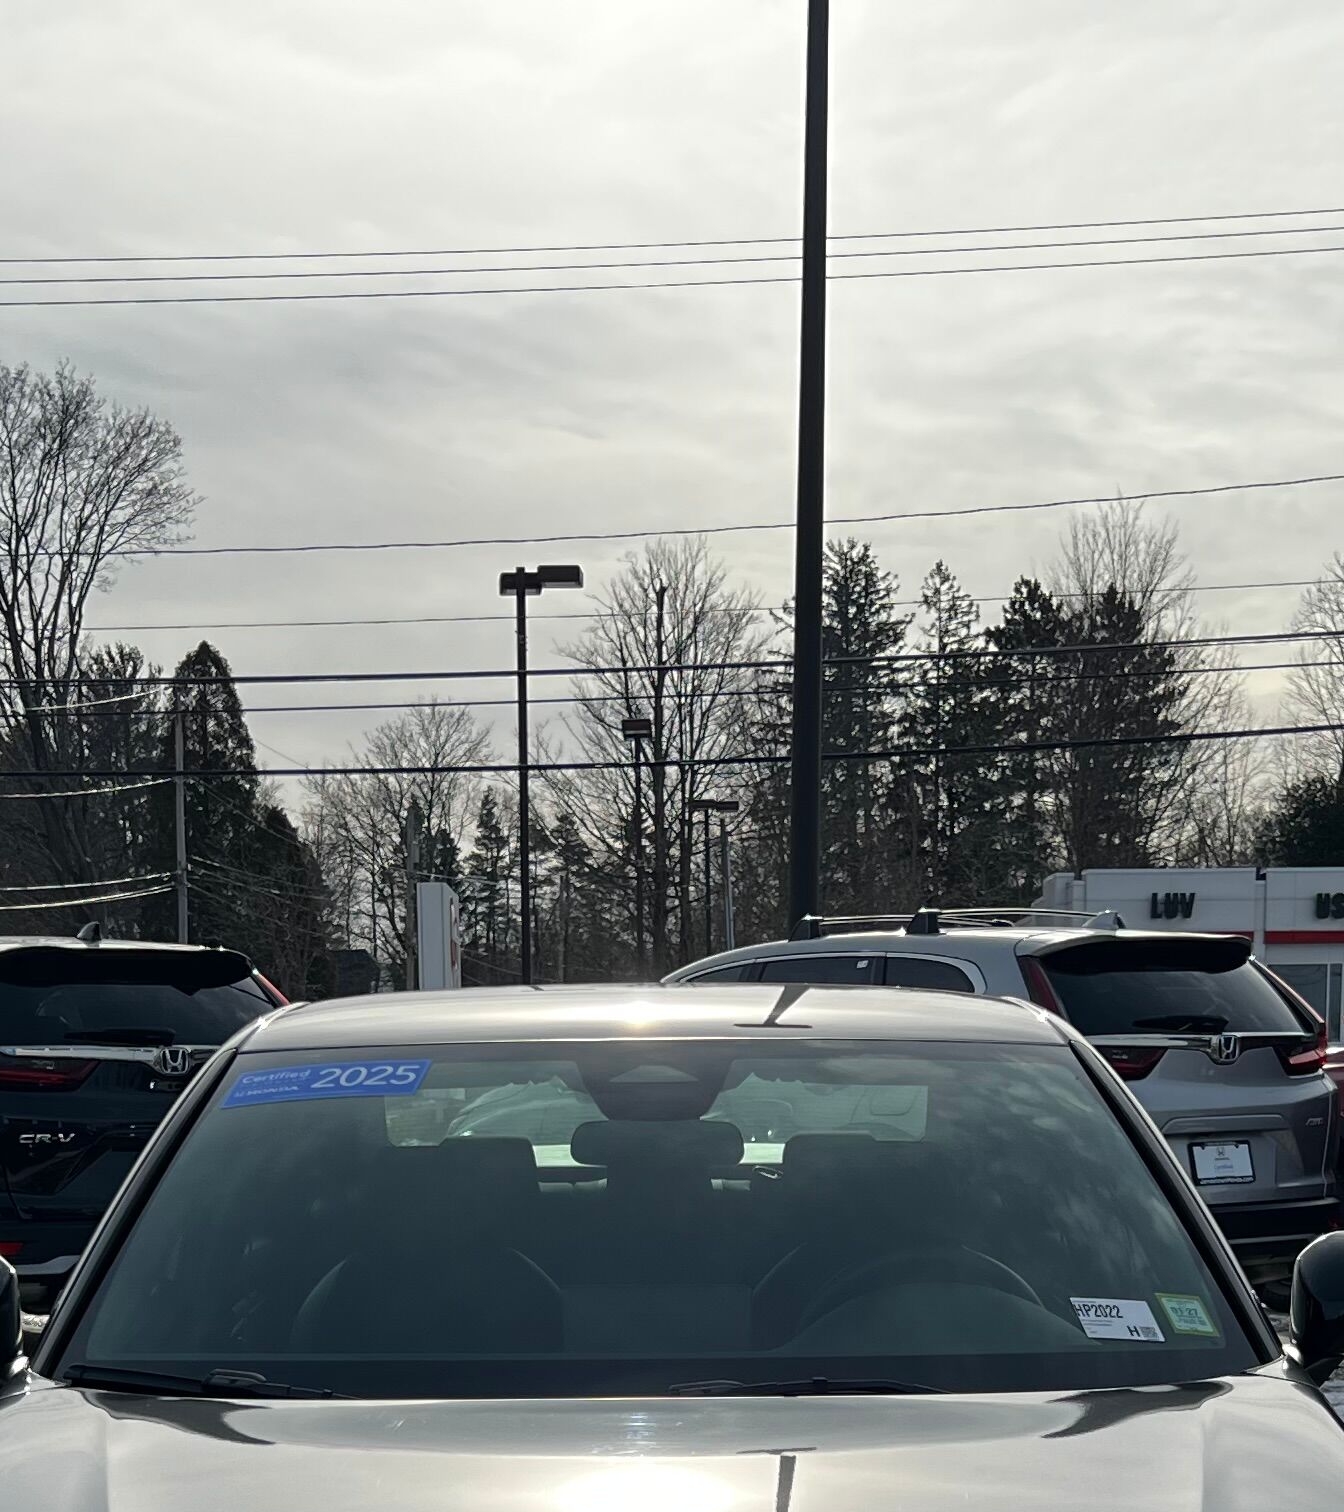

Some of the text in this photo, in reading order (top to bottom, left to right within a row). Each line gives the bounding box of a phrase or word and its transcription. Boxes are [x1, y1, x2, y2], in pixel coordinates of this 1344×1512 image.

[1150, 891, 1196, 919] LUV
[242, 1068, 311, 1084] Certified
[310, 1064, 421, 1089] 2025
[19, 1132, 76, 1144] CR-V
[1073, 1303, 1124, 1319] HP2022
